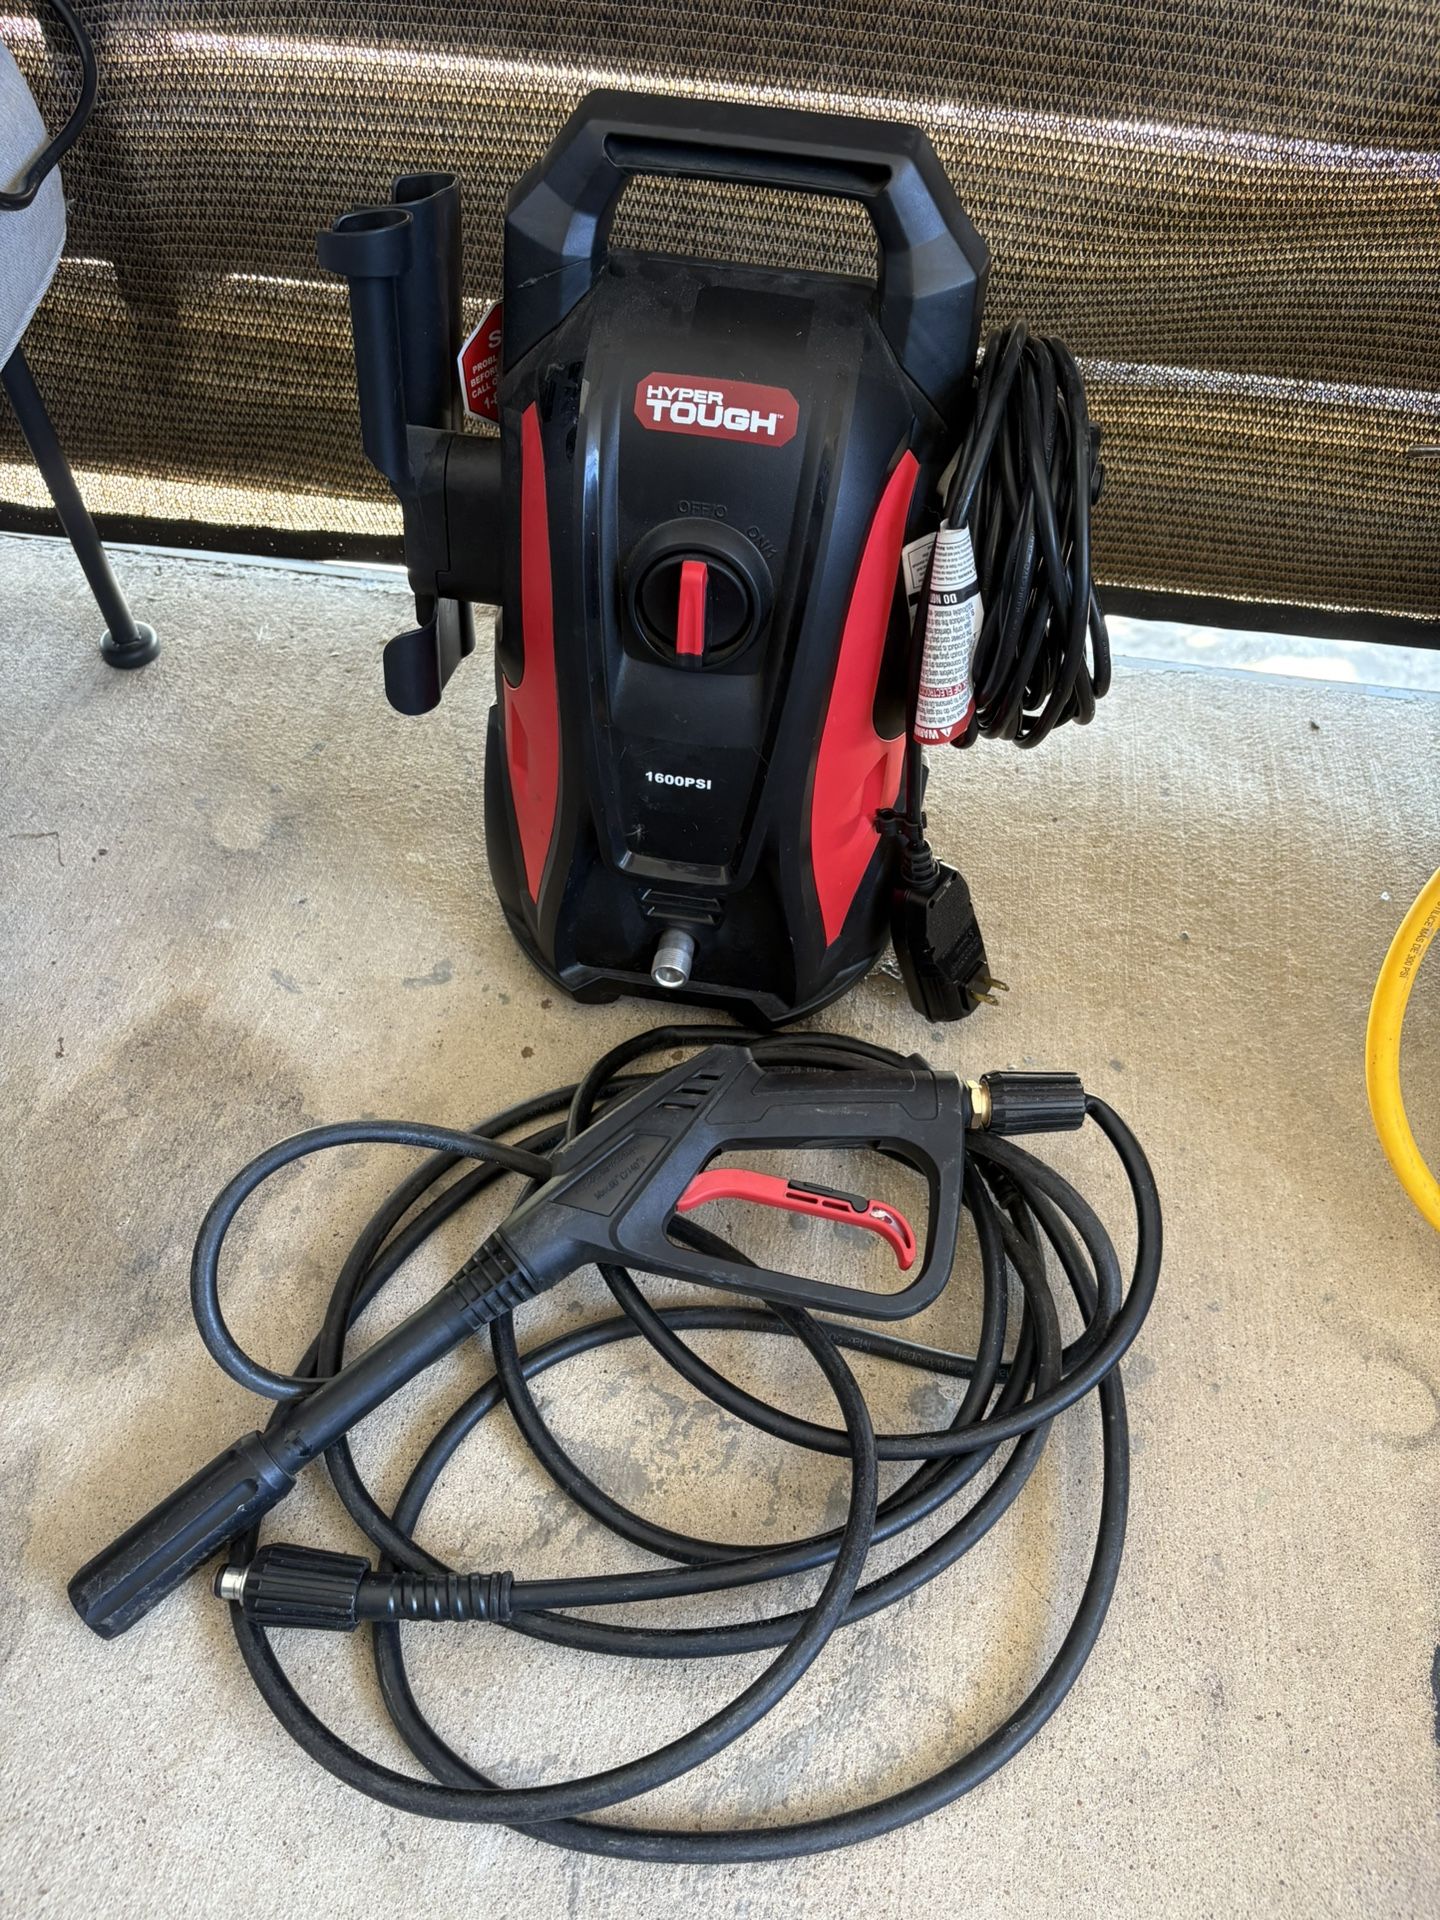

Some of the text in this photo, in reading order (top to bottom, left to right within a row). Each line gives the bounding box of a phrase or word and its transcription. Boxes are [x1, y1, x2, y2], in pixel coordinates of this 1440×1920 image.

[488, 329, 502, 348] S
[472, 355, 498, 375] PROBL
[471, 383, 490, 399] CALL
[646, 385, 724, 406] HYPER
[943, 593, 958, 605] DO
[953, 684, 963, 694] OF
[645, 771, 712, 790] 1600PSI
